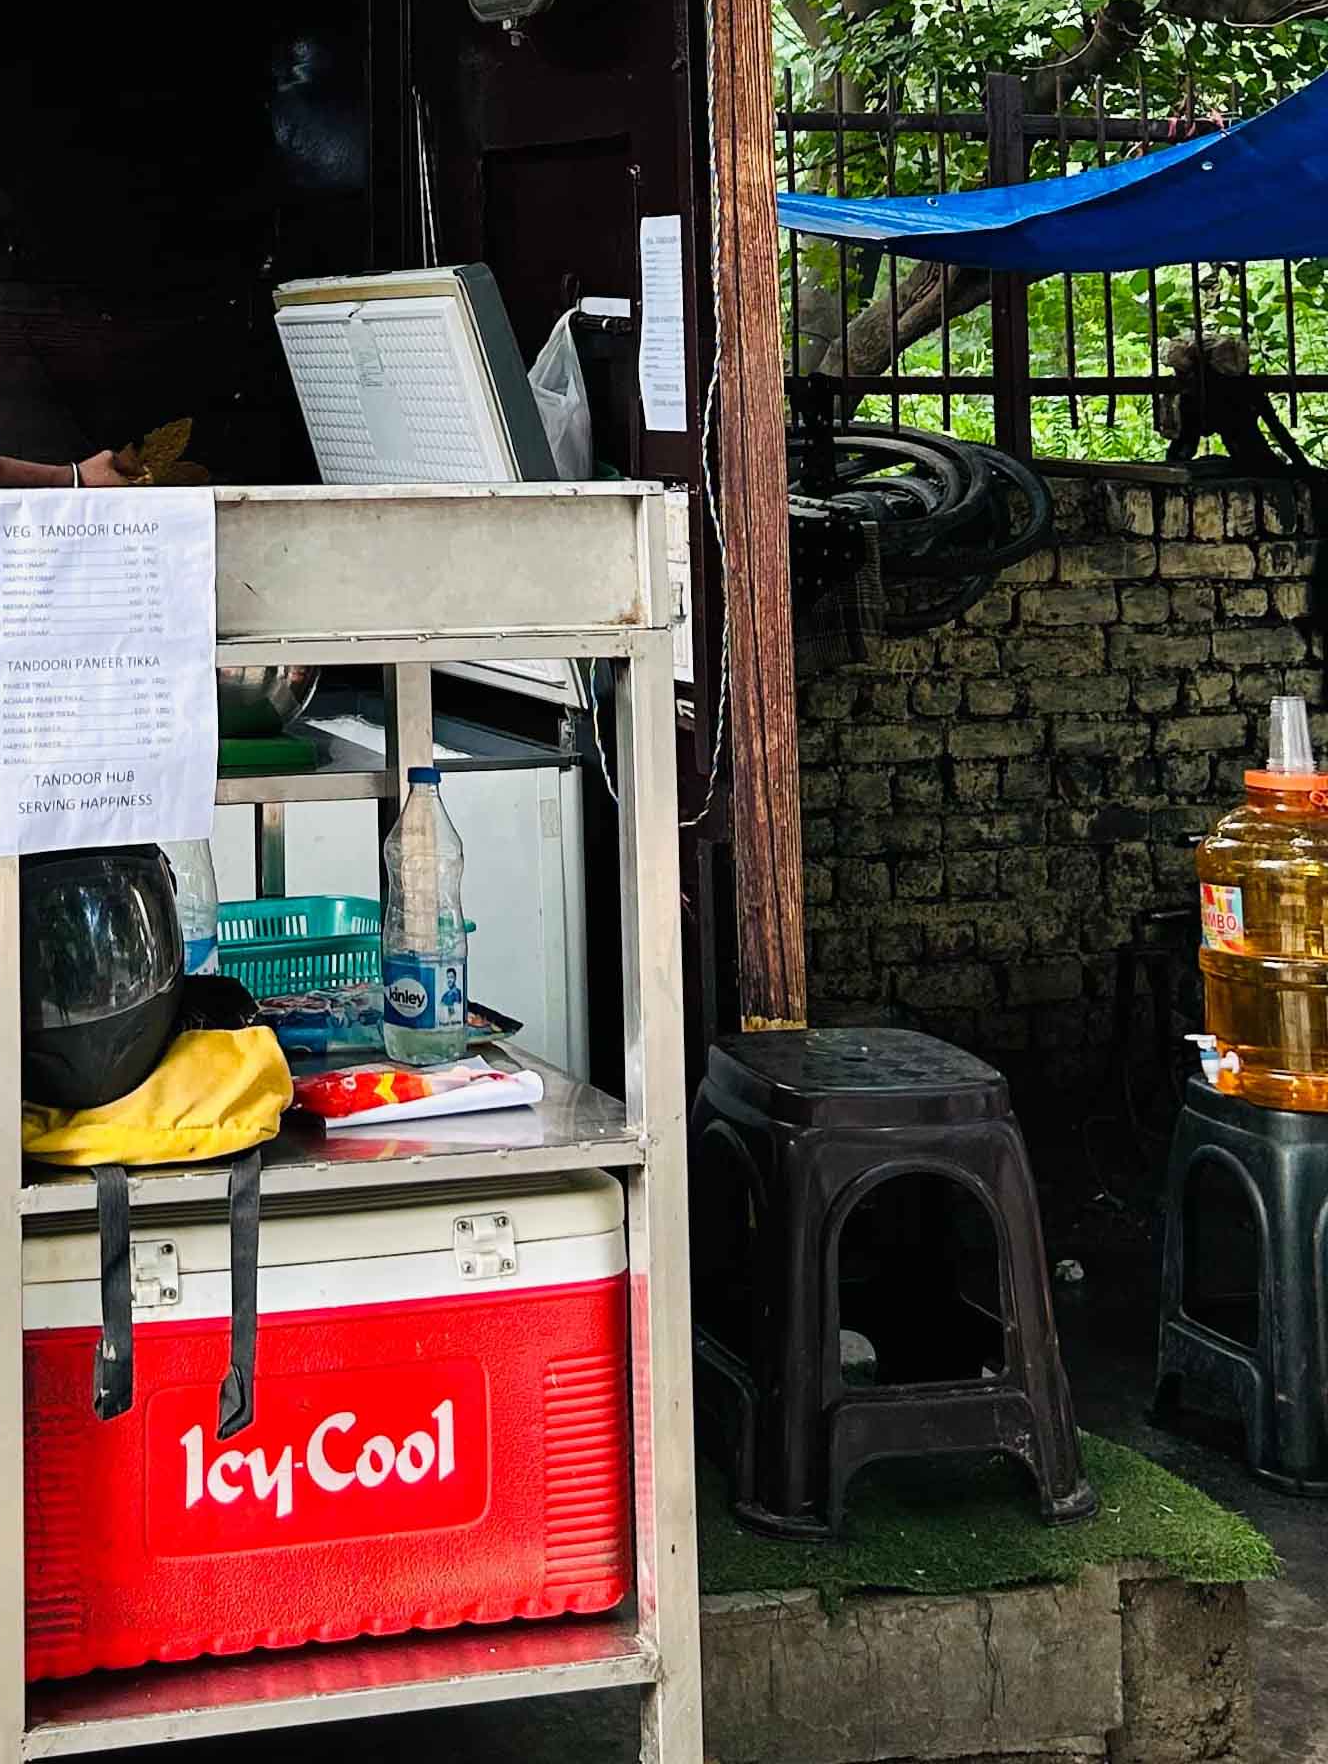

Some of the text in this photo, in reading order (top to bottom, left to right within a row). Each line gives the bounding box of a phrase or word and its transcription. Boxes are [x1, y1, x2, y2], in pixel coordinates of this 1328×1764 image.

[3, 522, 160, 539] VEG TANDOORI CHAAP
[7, 655, 161, 673] TANDOORI PANEER TIKKA
[34, 770, 135, 788] TANDOOR HUB
[18, 793, 153, 815] SERVING HAPPINESS
[1206, 911, 1237, 931] MBO
[389, 987, 426, 1009] kinley
[180, 1399, 455, 1518] Icy-Cool
